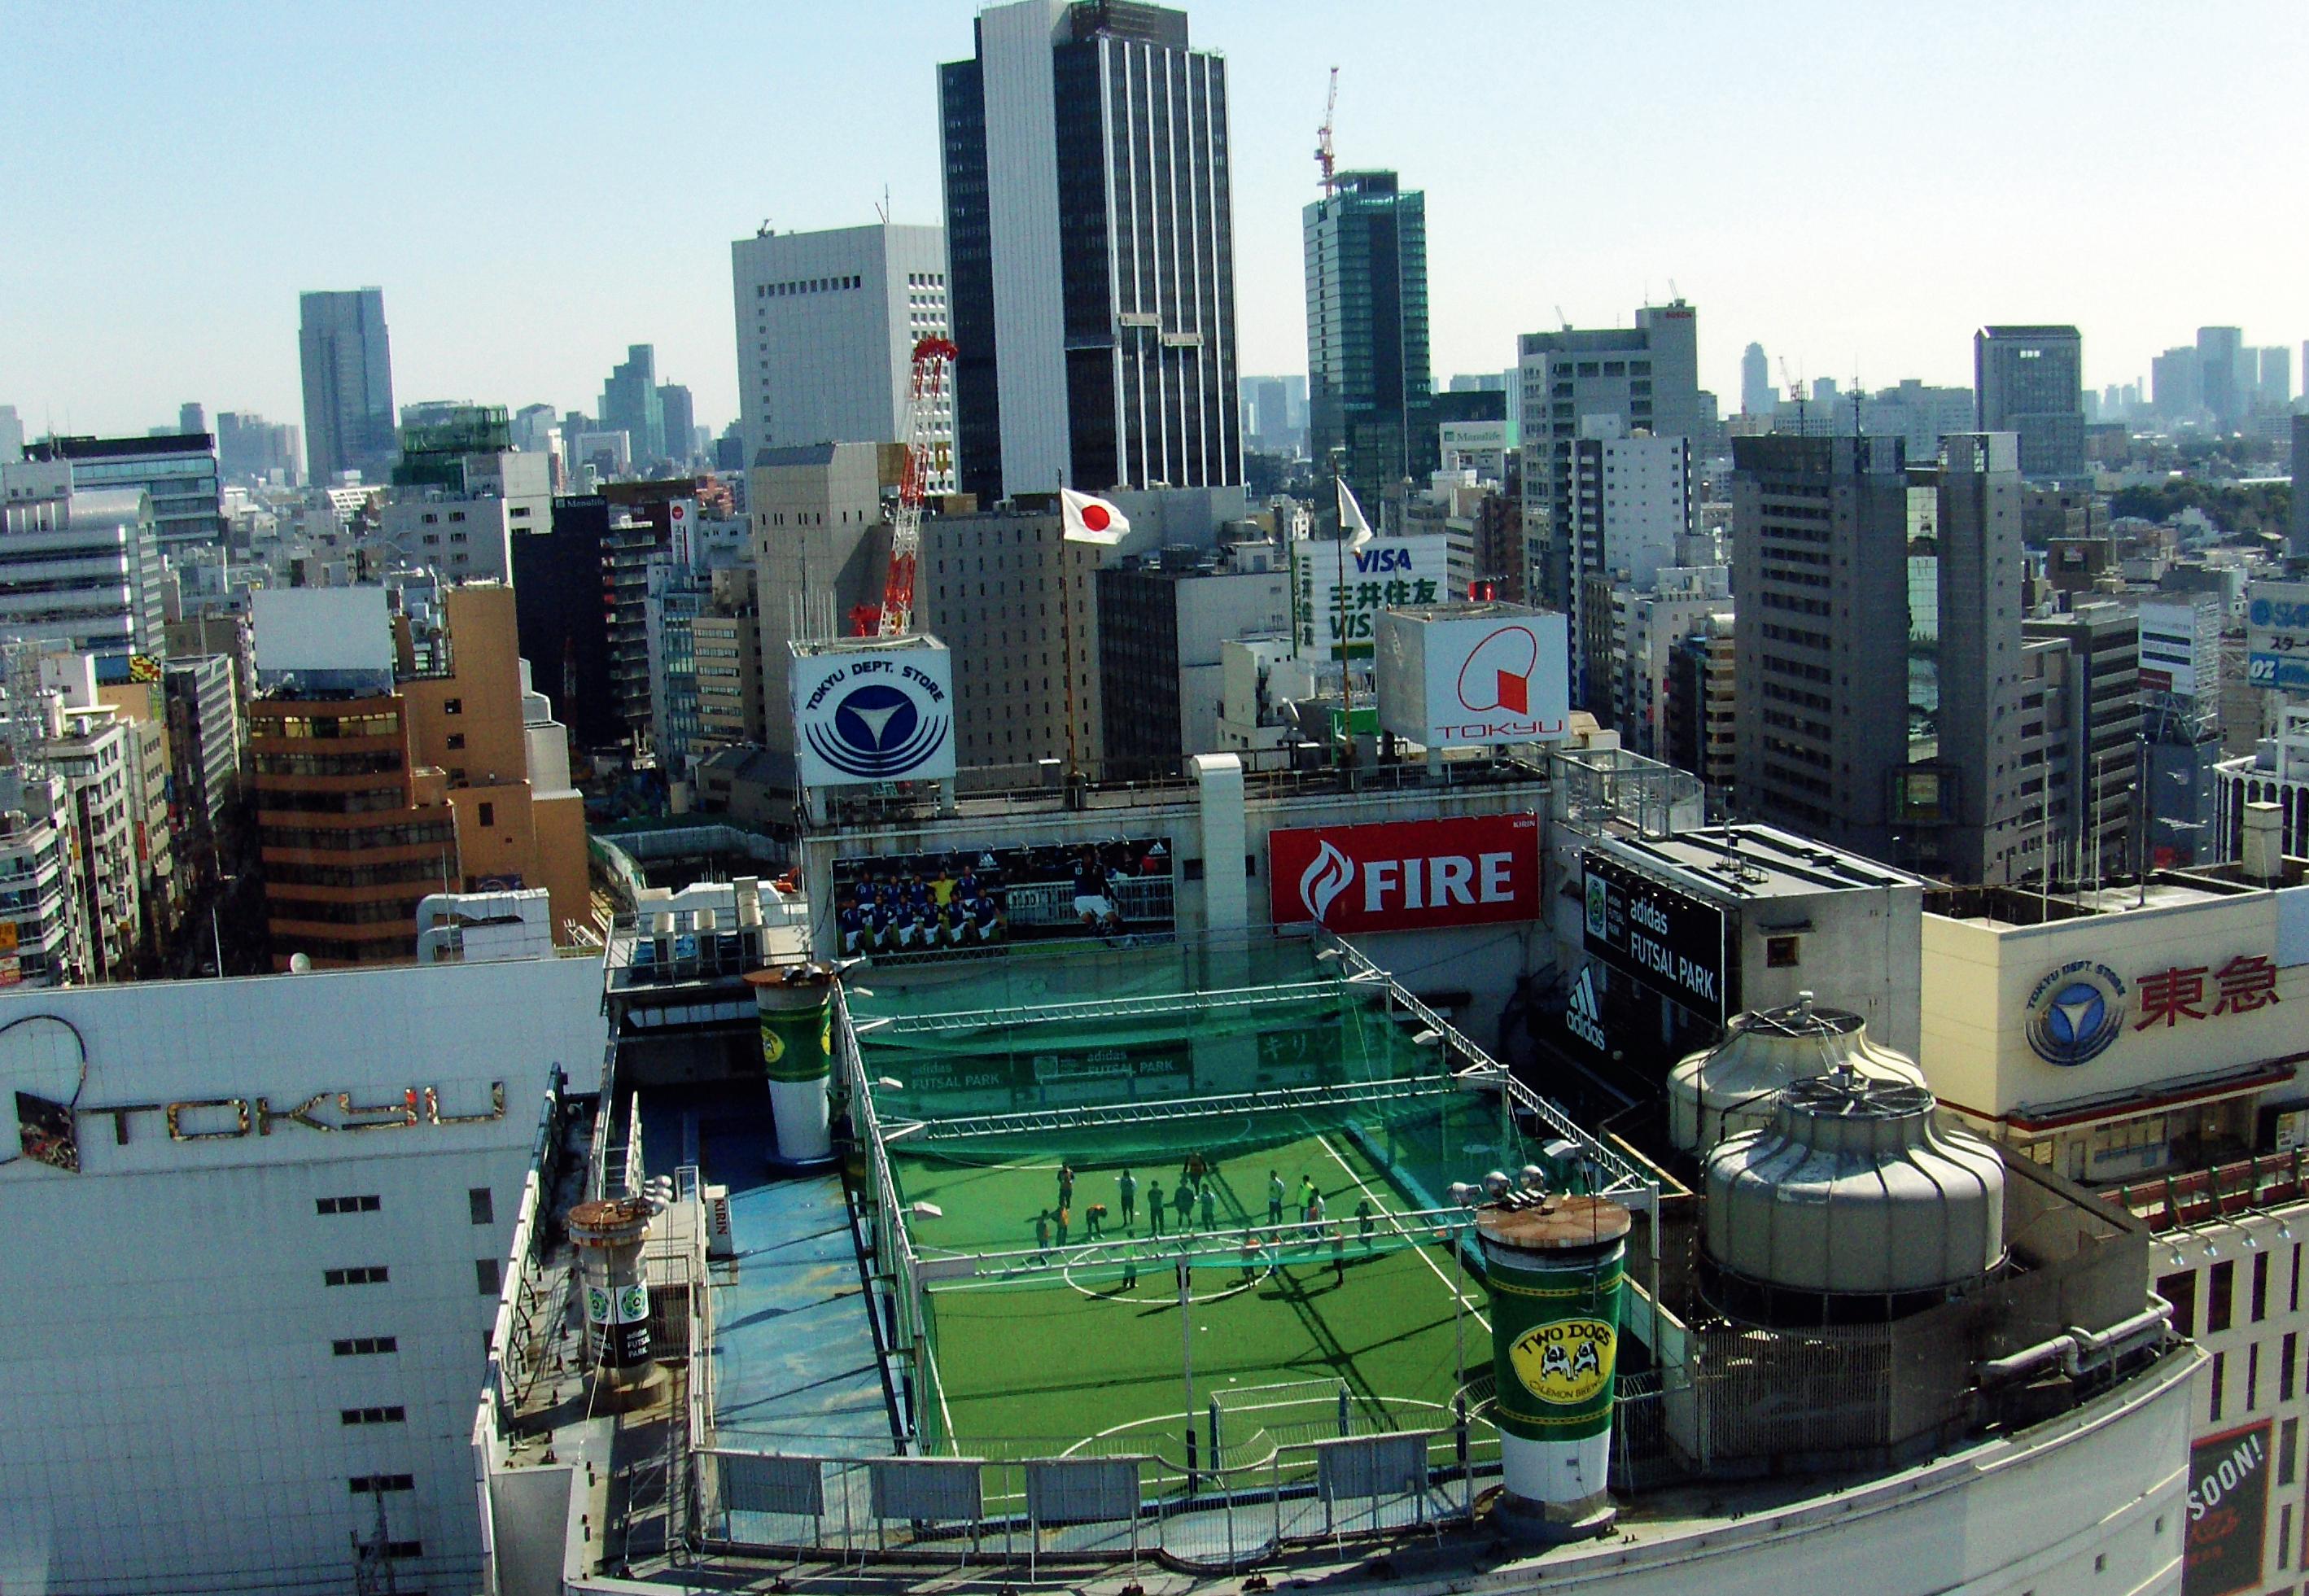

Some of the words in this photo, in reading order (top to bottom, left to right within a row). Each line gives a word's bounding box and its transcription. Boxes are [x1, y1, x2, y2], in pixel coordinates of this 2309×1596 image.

[1353, 549, 1412, 573] VISA
[1329, 578, 1438, 611] 三井住友
[1329, 613, 1375, 640] VIS
[806, 669, 846, 711] TOKYU
[851, 660, 894, 676] DEPT.
[901, 665, 945, 703] STORE
[1435, 719, 1563, 739] TOKYU
[1513, 820, 1536, 829] KIRIN
[1362, 851, 1515, 912] FIRE
[1630, 896, 1668, 936] adidas
[1630, 930, 1677, 982] FUTSAL
[2027, 969, 2059, 1010] TOKYU
[2132, 954, 2281, 1032] 東急
[1566, 1009, 1606, 1052] adidas
[912, 1076, 962, 1090] FUTSAL
[77, 1081, 506, 1145] TOKYU
[715, 1199, 728, 1235] KIRIN
[1517, 1327, 1563, 1355] TWO
[1568, 1323, 1611, 1347] DOGS
[1540, 1385, 1573, 1399] LEMON
[2186, 1433, 2263, 1521] SOON!
